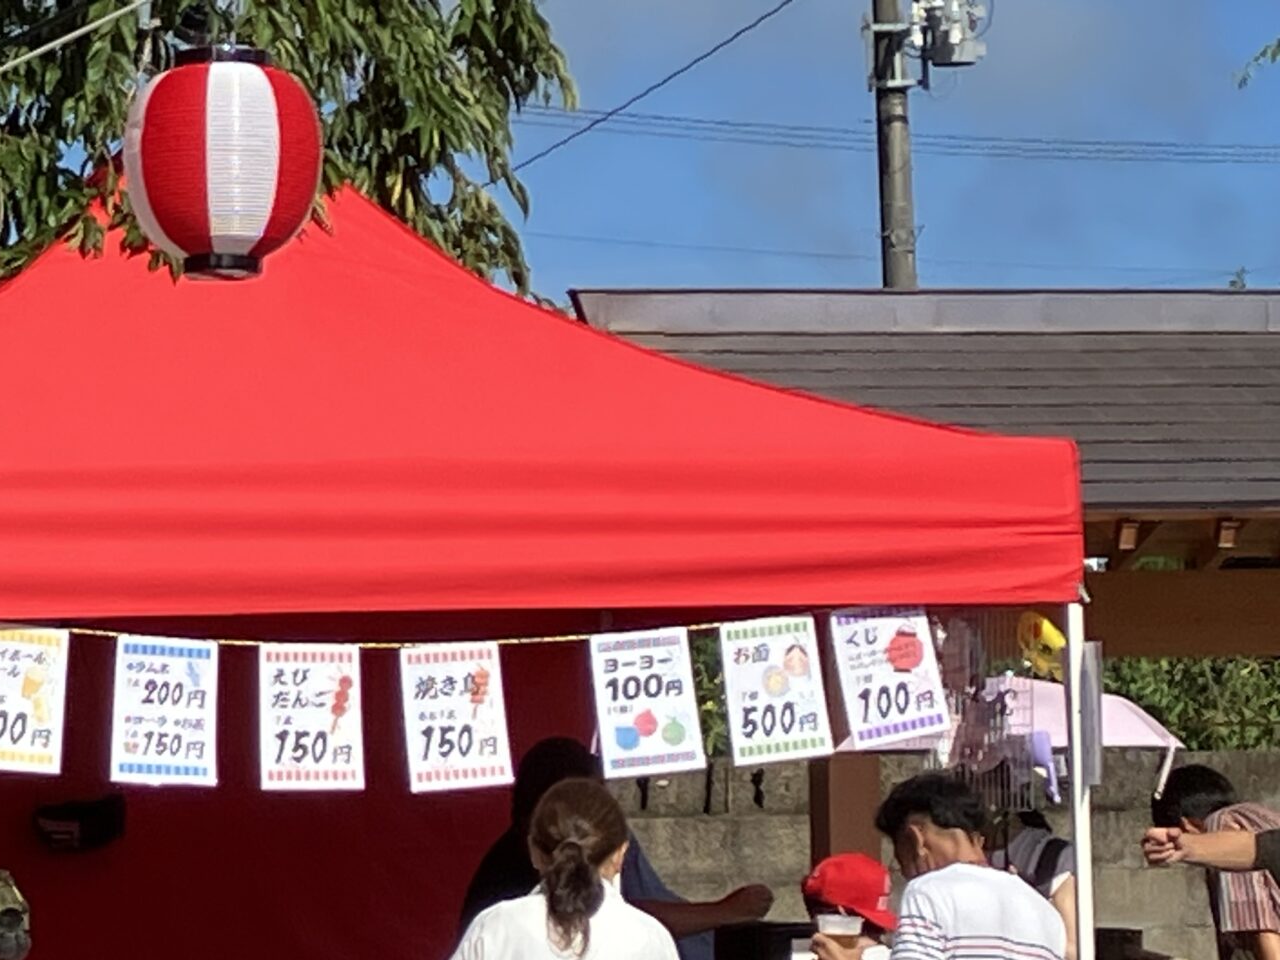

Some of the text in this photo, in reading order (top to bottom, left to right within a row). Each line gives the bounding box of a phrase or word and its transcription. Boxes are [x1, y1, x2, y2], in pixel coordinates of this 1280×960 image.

[846, 627, 878, 647] くじ
[271, 668, 311, 687] えび
[604, 655, 673, 674] ヨーヨー
[141, 679, 206, 709] 200円
[414, 672, 480, 700] 焼き鳥
[605, 673, 683, 702] 100円
[858, 681, 935, 723] 100円
[742, 701, 818, 738] 500円
[143, 731, 206, 760] 150円
[275, 729, 352, 765] 150円
[421, 723, 498, 761] 150円
